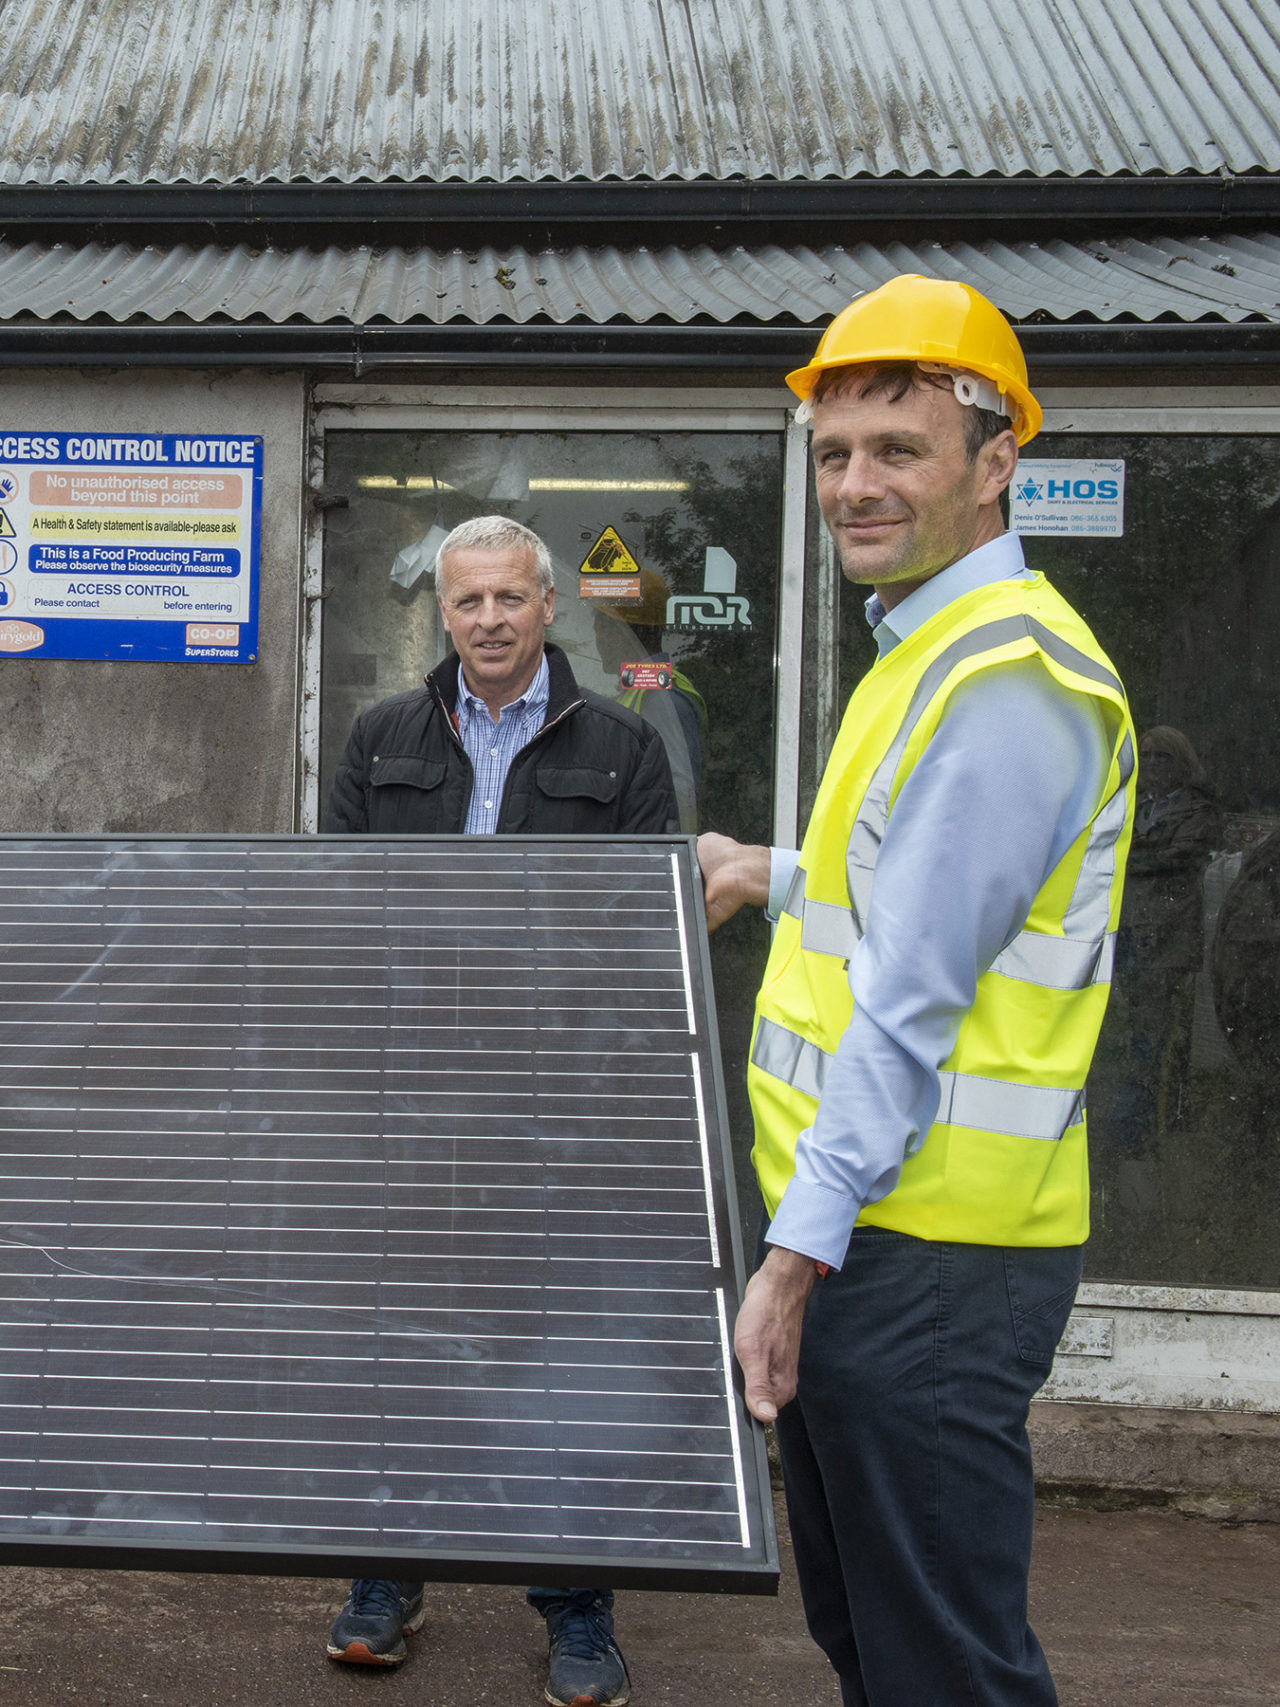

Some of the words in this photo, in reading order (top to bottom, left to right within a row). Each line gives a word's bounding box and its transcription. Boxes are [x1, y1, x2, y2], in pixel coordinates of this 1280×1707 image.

[66, 438, 168, 461] CONTROL
[175, 440, 254, 463] NOTICE
[46, 474, 67, 488] No
[71, 475, 168, 490] unauthorised
[172, 479, 224, 490] access
[1048, 480, 1118, 499] HOS
[71, 489, 126, 505] beyond
[130, 490, 157, 502] this
[161, 491, 199, 505] point
[32, 519, 40, 529] A
[41, 518, 67, 530] Health
[68, 519, 74, 530] &
[76, 519, 102, 533] Safety
[103, 520, 144, 531] statement
[145, 520, 152, 531] is
[154, 520, 220, 535] available-please
[221, 522, 236, 533] ask
[40, 547, 66, 559] This
[69, 548, 80, 559] is
[82, 550, 90, 559] a
[93, 548, 124, 560] Food
[127, 549, 190, 564] Producing
[193, 550, 224, 562] Farm
[35, 560, 67, 570] Please
[69, 560, 109, 571] observe
[110, 562, 126, 571] the
[128, 562, 182, 574] biosecurity
[184, 564, 232, 574] measures
[67, 583, 121, 596] ACCESS
[125, 584, 190, 597] CONTROL
[34, 598, 64, 607] Please
[66, 599, 100, 608] contact
[163, 601, 193, 610] before
[195, 602, 232, 613] entering
[190, 628, 235, 640] CO-OP
